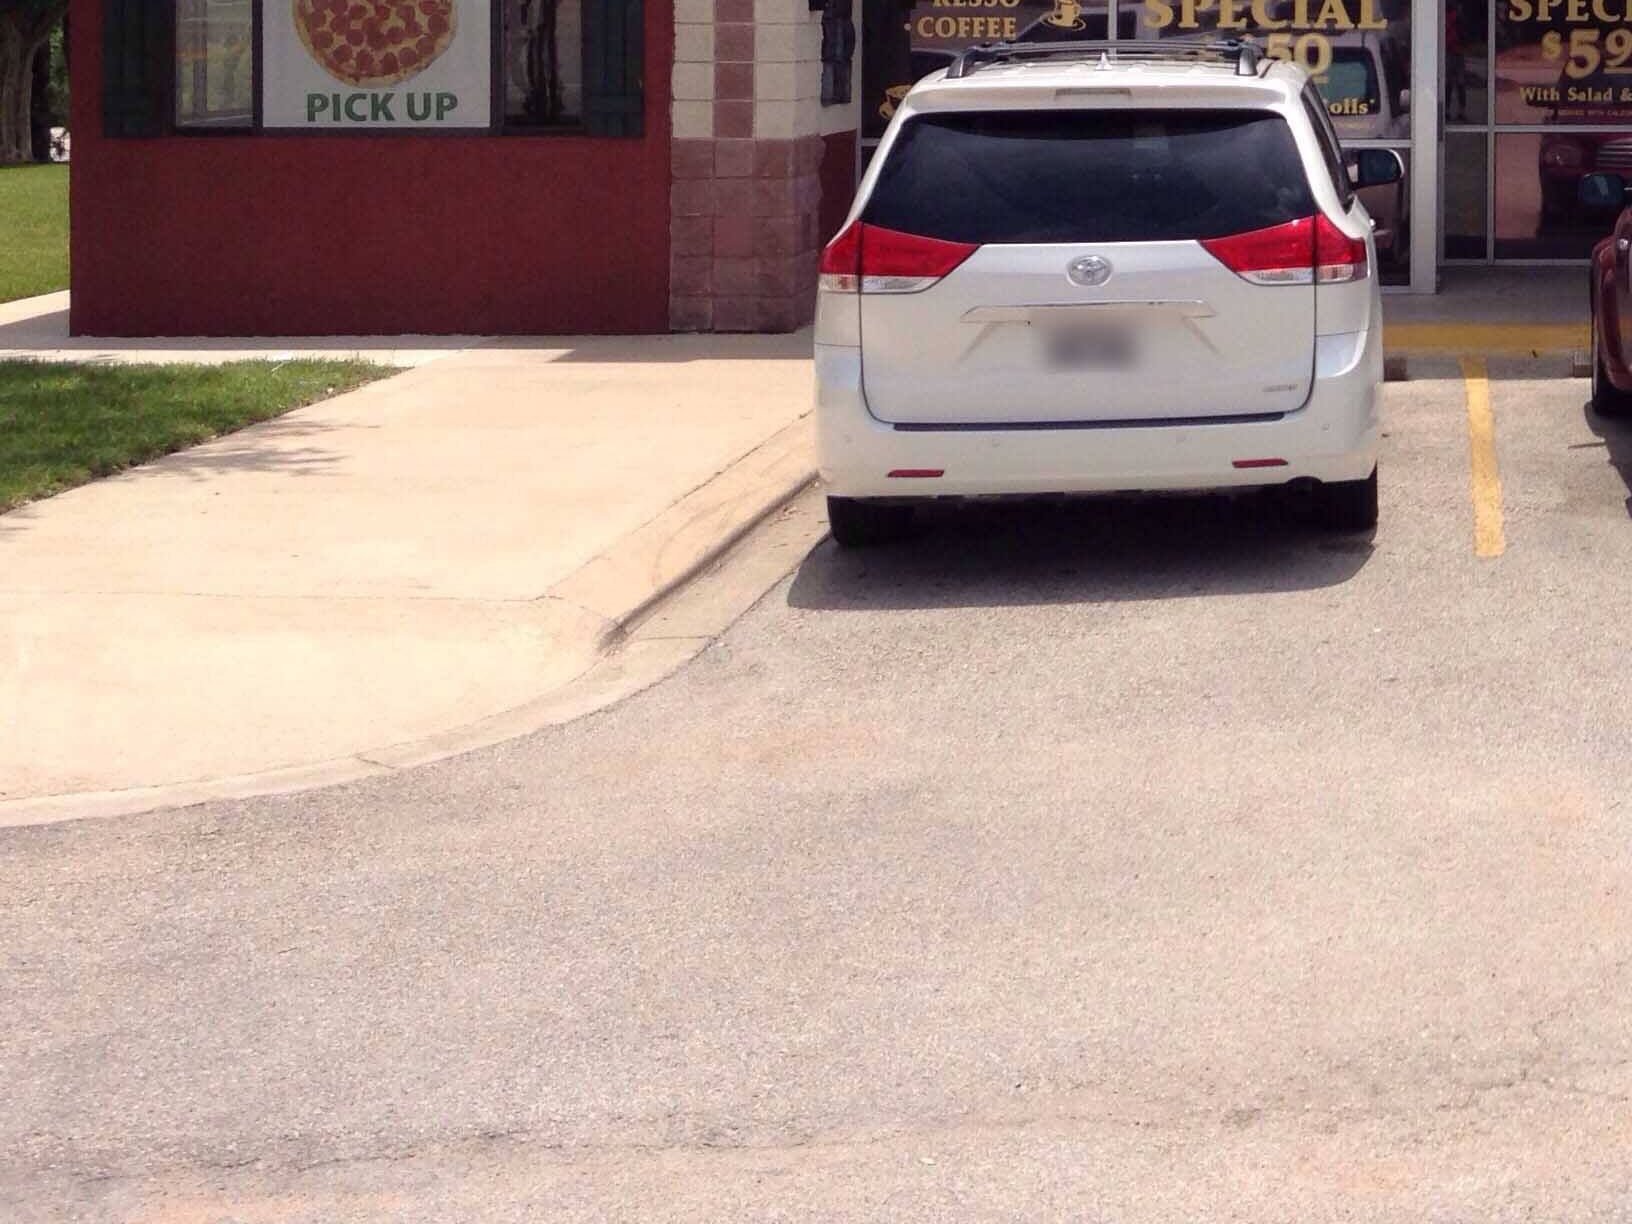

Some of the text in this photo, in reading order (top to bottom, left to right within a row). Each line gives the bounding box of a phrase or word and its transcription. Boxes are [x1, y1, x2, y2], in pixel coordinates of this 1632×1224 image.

[917, 16, 1017, 39] COFFEE
[1519, 87, 1560, 102] With
[1567, 87, 1613, 102] Salad
[1619, 87, 1632, 102] &
[307, 92, 459, 122] PICK UP
